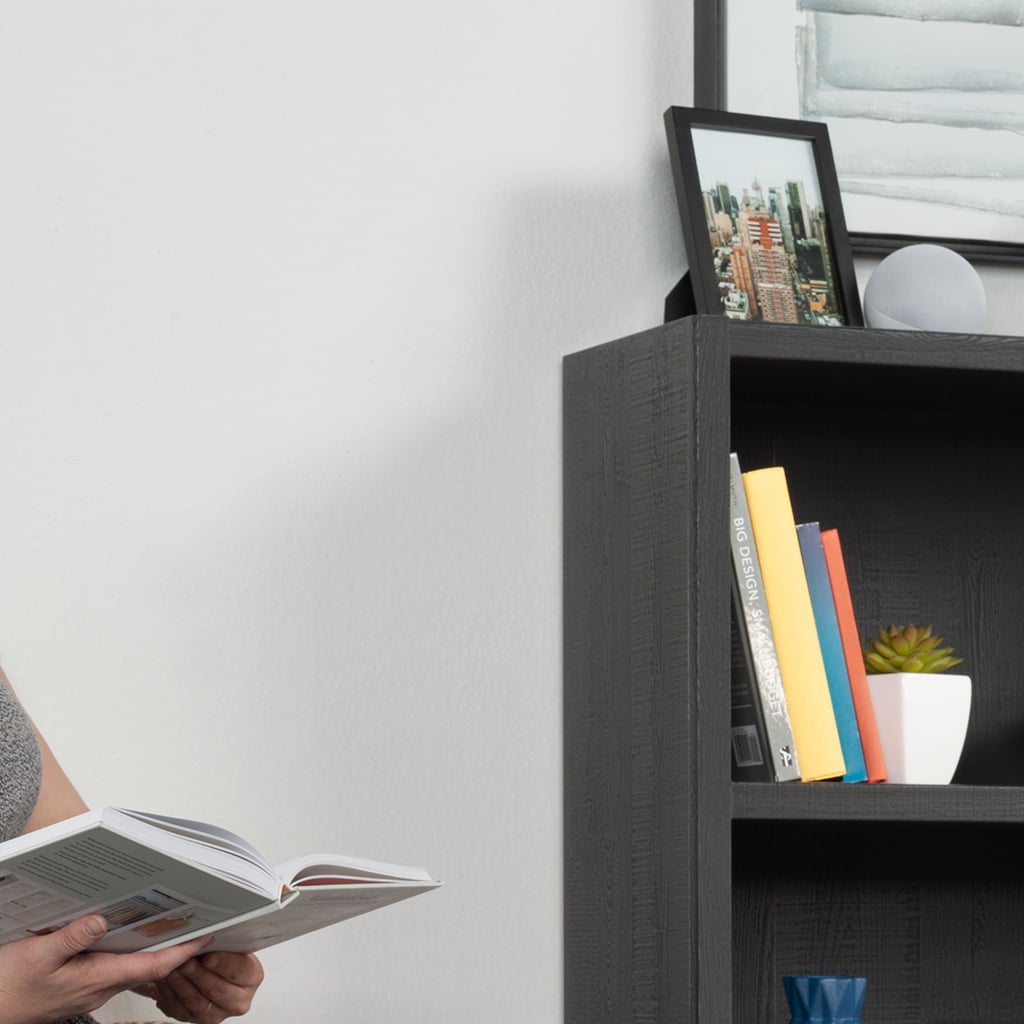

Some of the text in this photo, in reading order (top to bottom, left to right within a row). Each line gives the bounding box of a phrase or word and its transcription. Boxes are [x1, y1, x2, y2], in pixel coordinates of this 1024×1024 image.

[734, 517, 783, 717] BIG DESIGN, SMALL BUDGET
